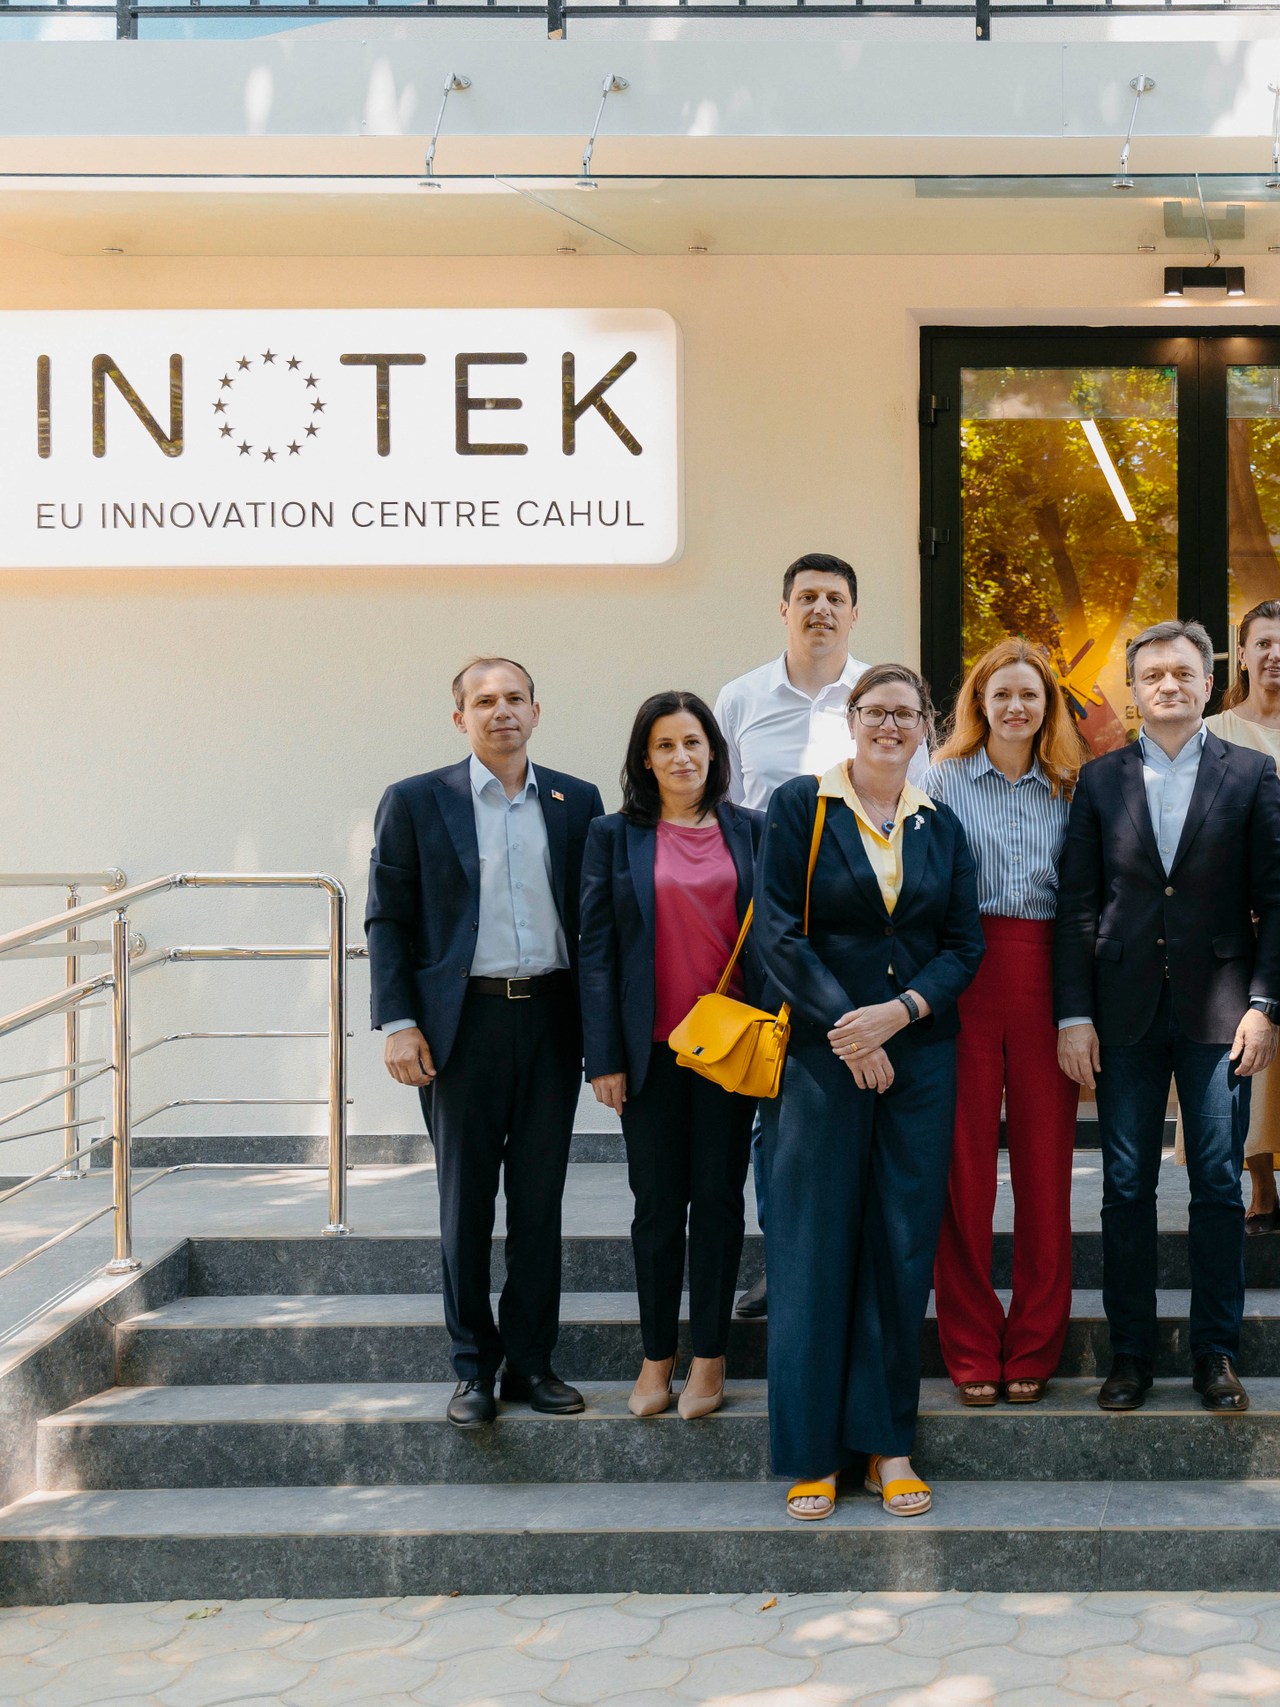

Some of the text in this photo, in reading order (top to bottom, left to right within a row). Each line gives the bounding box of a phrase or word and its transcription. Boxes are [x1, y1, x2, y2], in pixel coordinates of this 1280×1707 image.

[37, 500, 645, 529] EU INNOVATION CENTRE CAHUL
